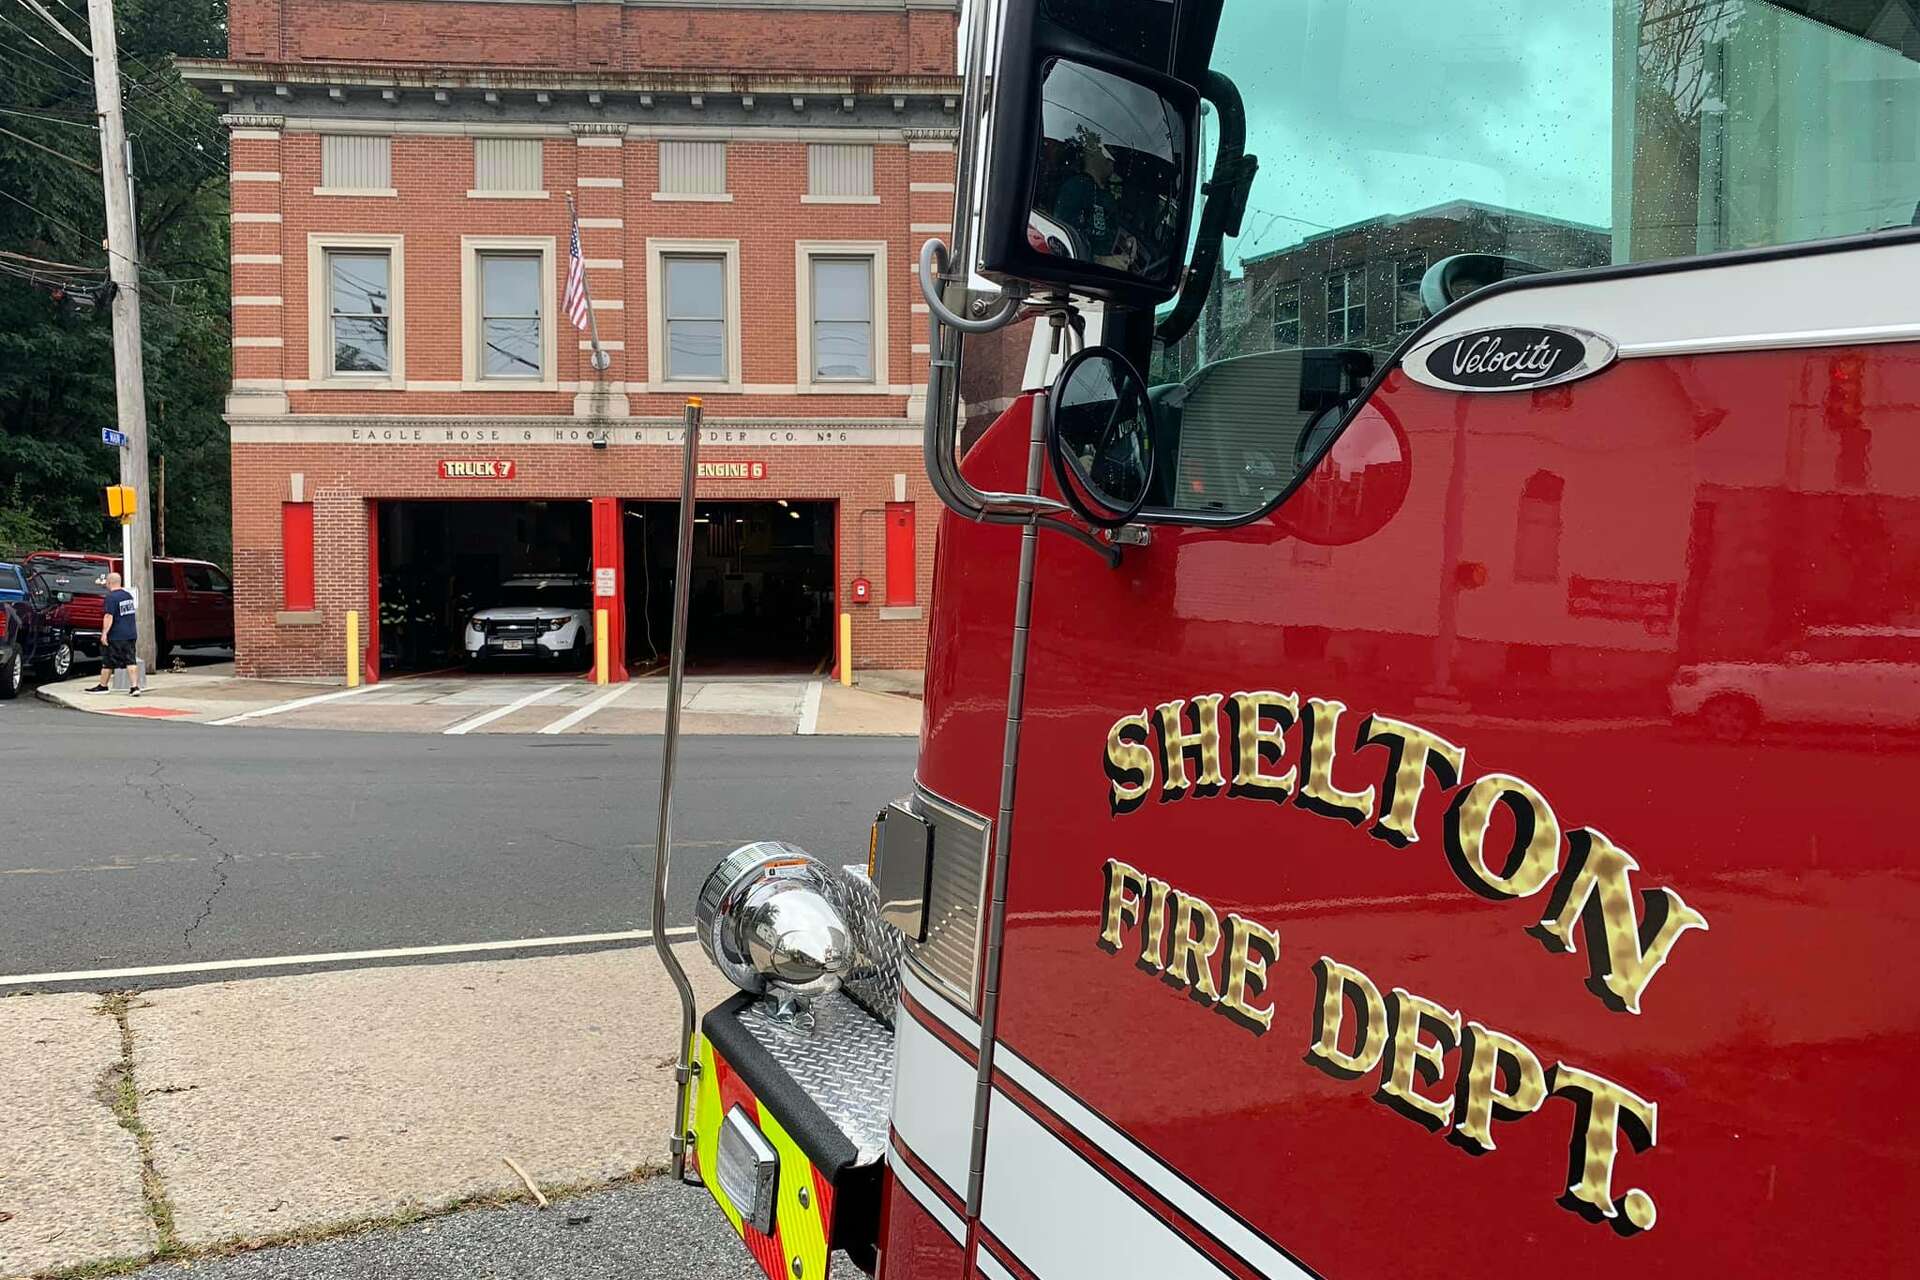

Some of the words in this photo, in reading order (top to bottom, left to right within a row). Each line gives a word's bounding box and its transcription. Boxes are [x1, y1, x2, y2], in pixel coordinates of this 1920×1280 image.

[1452, 335, 1562, 382] Velocity
[352, 429, 422, 441] EAGLE
[446, 430, 499, 441] HOSE
[523, 430, 531, 441] &
[556, 430, 609, 441] HOOK
[635, 431, 642, 441] &
[667, 431, 747, 442] LDER
[770, 432, 797, 442] CO.
[840, 432, 847, 442] 6
[443, 461, 497, 477] TRUCK
[498, 461, 512, 477] 7
[697, 463, 748, 477] ENGINE
[752, 463, 763, 477] 6
[1103, 690, 1709, 1015] SHELTON
[1096, 858, 1280, 1037] FIRE
[1302, 955, 1658, 1237] DEPT.
